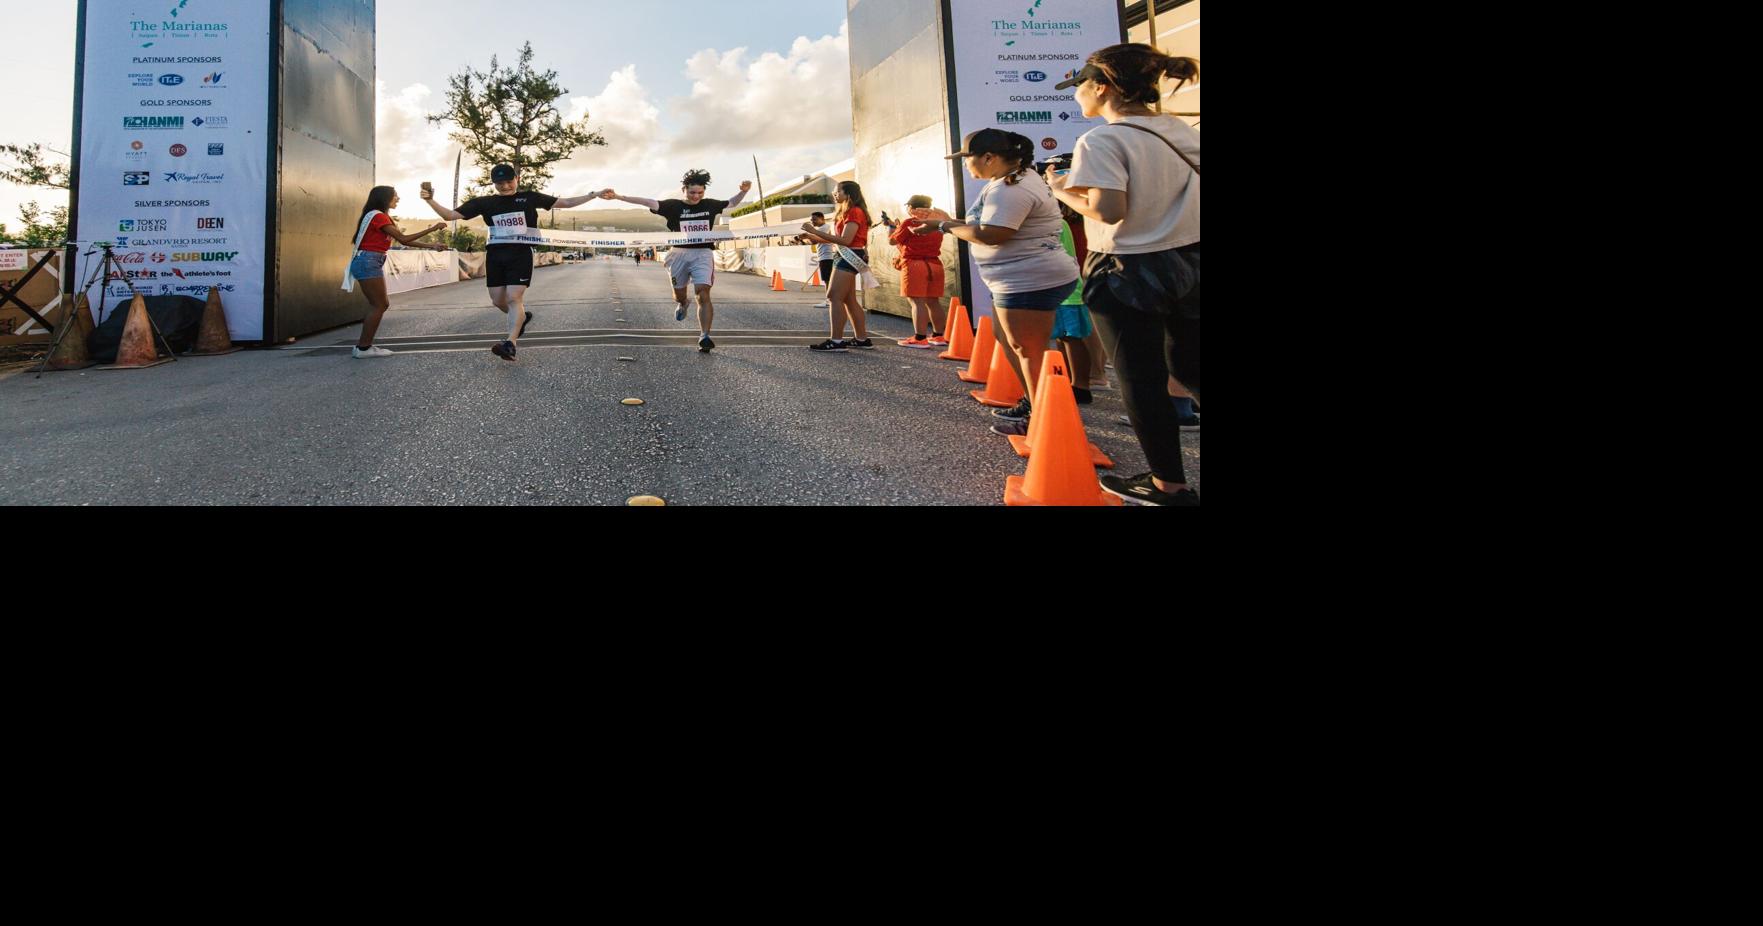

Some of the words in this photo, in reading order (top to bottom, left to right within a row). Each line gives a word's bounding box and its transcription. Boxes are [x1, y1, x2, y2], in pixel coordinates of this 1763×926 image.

[130, 20, 157, 31] The
[162, 20, 228, 31] Marianas
[992, 20, 1017, 30] The
[1021, 20, 1081, 30] Marianas
[133, 56, 175, 64] PLATINUM
[1038, 53, 1079, 61] SPONSORS
[1033, 94, 1075, 102] SPONSORS
[140, 99, 165, 107] GOLD
[167, 99, 212, 107] SPONSORS
[170, 146, 186, 154] DFS
[176, 173, 199, 183] Royal
[201, 172, 224, 180] Travel
[134, 200, 162, 208] SILVER
[164, 199, 210, 207] SPONSORS
[137, 218, 167, 226] TOKYO
[197, 217, 224, 229] DEEN
[496, 216, 524, 227] 10988
[683, 224, 709, 232] 10866
[191, 237, 228, 245] RESORT
[516, 235, 551, 243] FINISHER
[170, 251, 239, 262] SUBWAY
